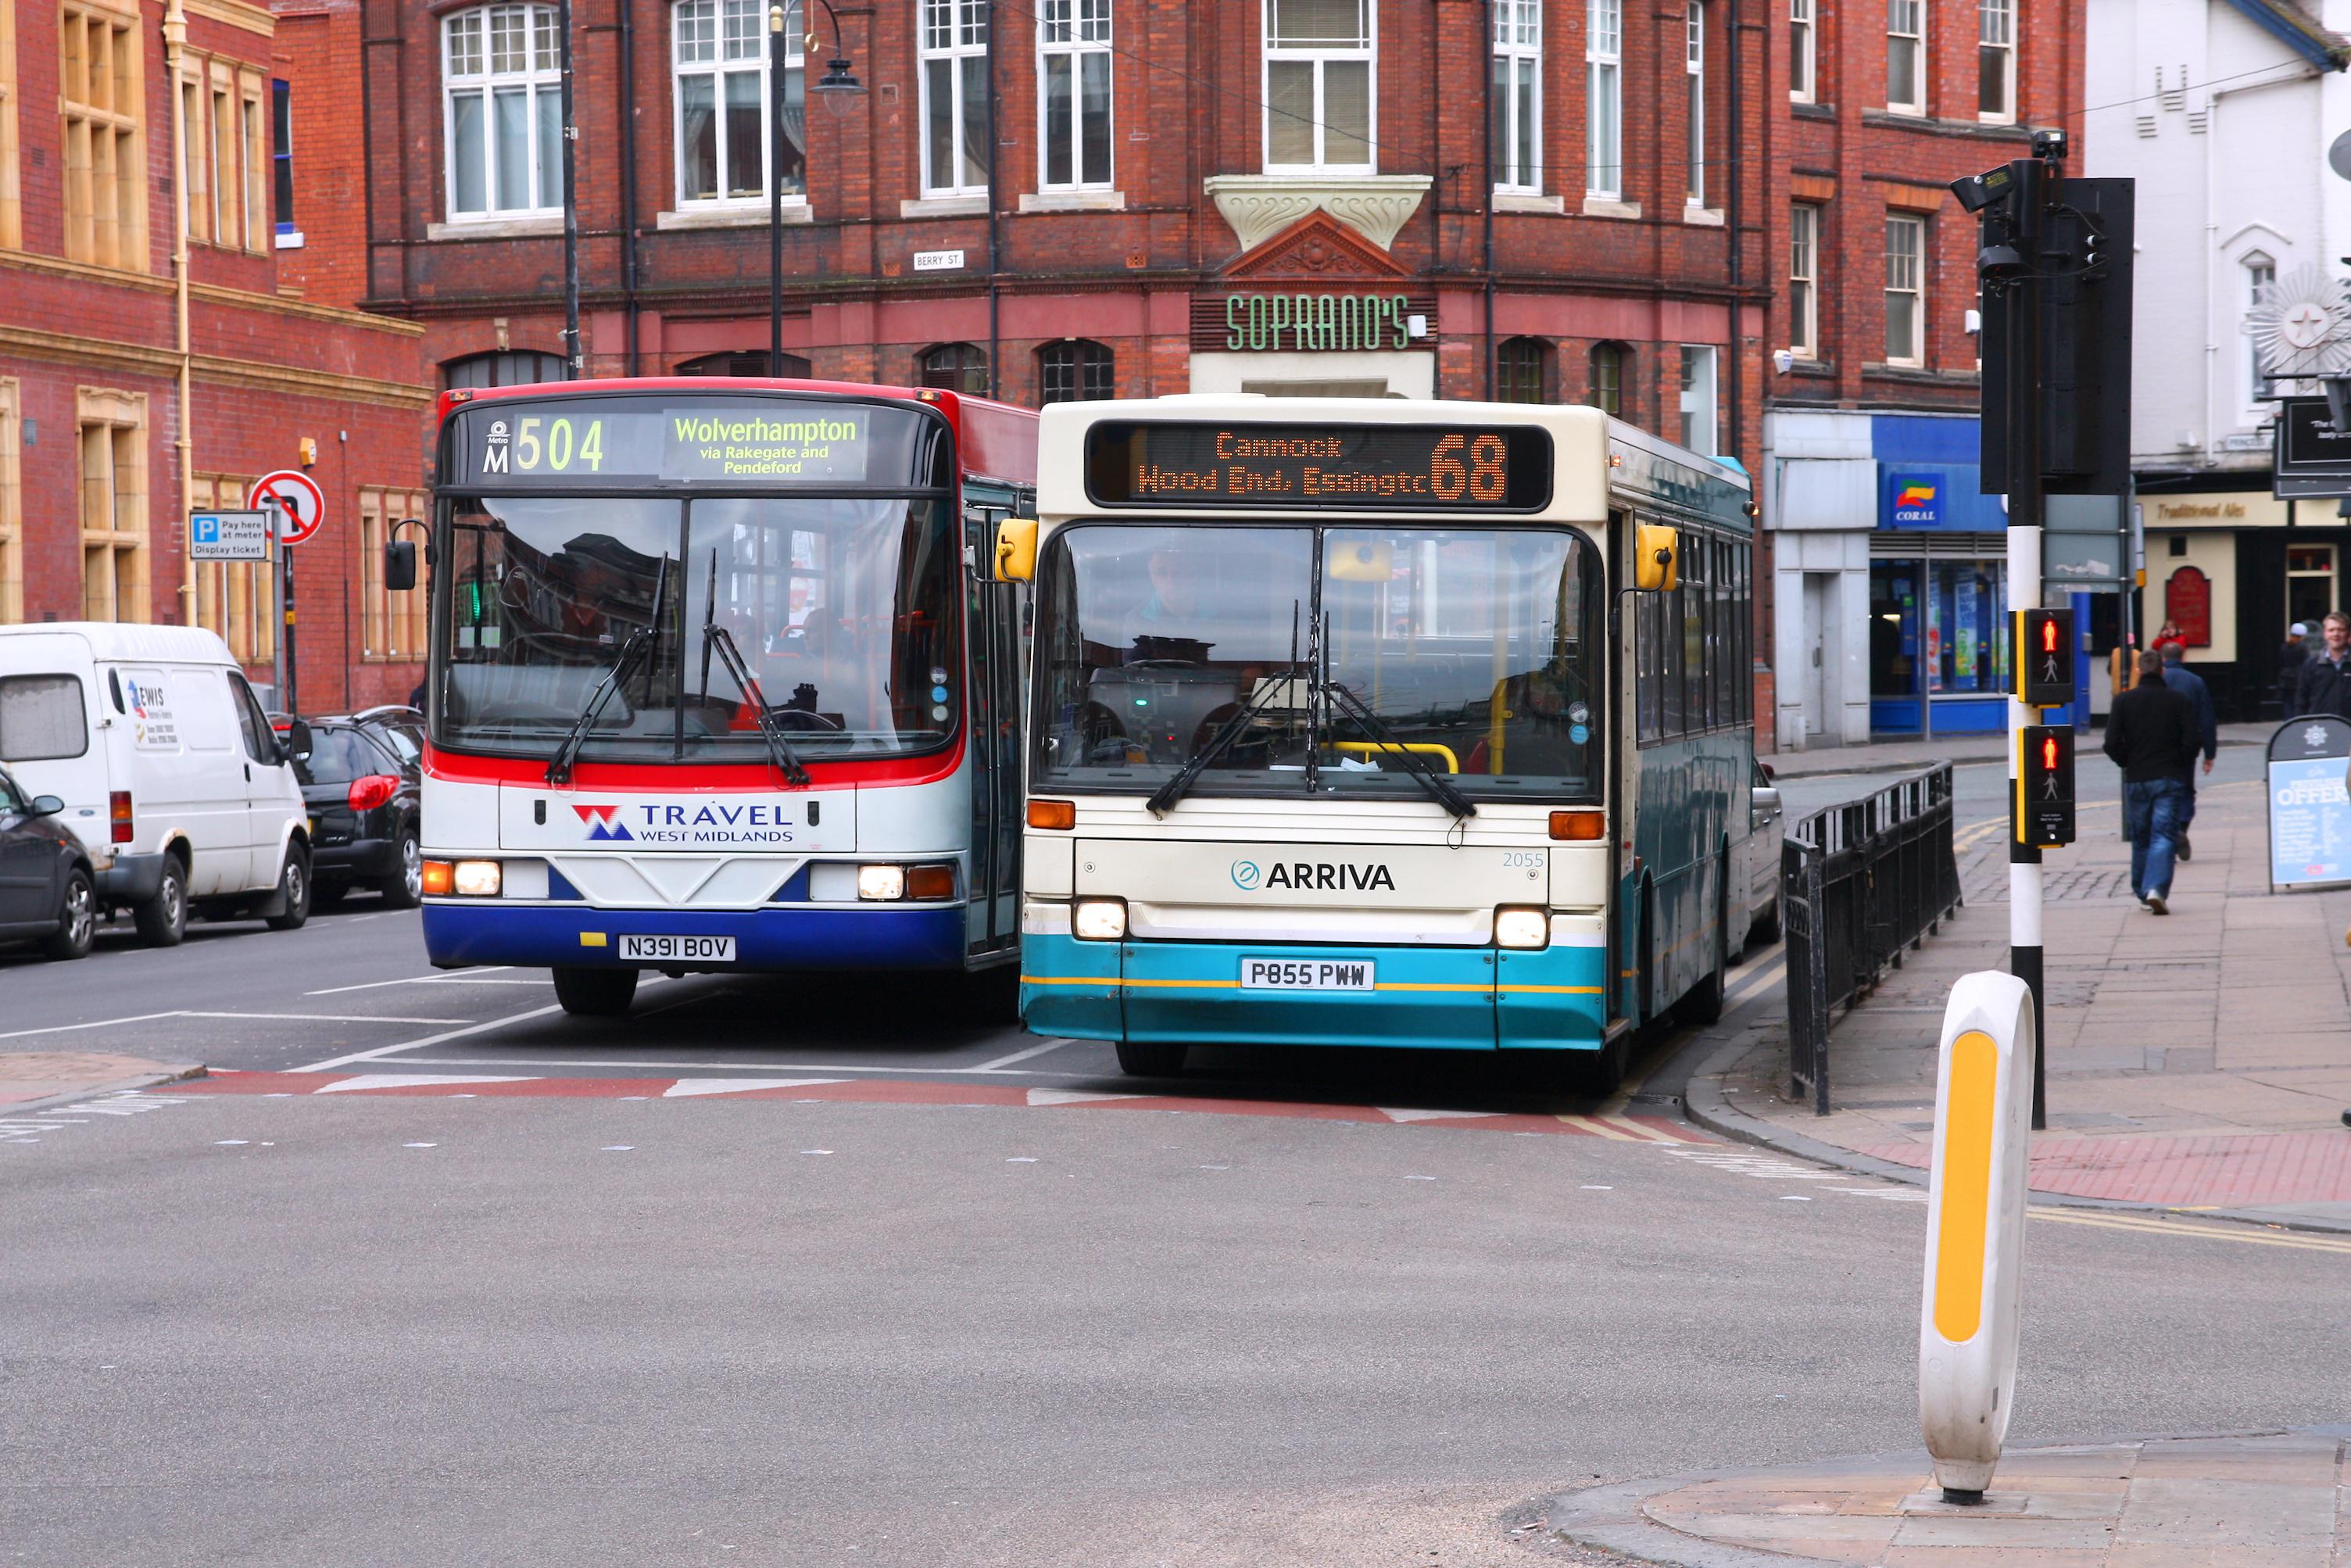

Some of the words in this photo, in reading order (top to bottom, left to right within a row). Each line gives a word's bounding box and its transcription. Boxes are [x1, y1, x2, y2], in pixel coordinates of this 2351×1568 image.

[917, 256, 943, 266] BERRY
[948, 255, 961, 264] ST.
[1227, 294, 1408, 350] SOPRANO'S
[675, 417, 856, 446] Wolverhampton
[517, 417, 603, 471] 504
[700, 447, 721, 460] via
[725, 446, 796, 460] Rakegate
[801, 446, 828, 458] and
[1216, 431, 1342, 460] Cannock
[482, 446, 508, 473] M
[724, 461, 802, 474] Pendeford
[1431, 434, 1506, 501] 68
[1139, 464, 1217, 493] Wood
[1229, 466, 1291, 494] End,
[1896, 510, 1936, 521] CORAL
[199, 520, 215, 540] P
[195, 546, 230, 554] Display
[134, 686, 164, 707] LEWIS
[639, 805, 793, 825] TRAVEL
[640, 832, 688, 842] WEST
[694, 831, 793, 842] MIDLANDS
[1503, 852, 1544, 868] 2055
[1265, 862, 1396, 890] ARRIVA
[628, 938, 678, 957] N391
[684, 938, 728, 957] BOV
[1251, 963, 1312, 985] P855
[1319, 965, 1365, 986] PWW
